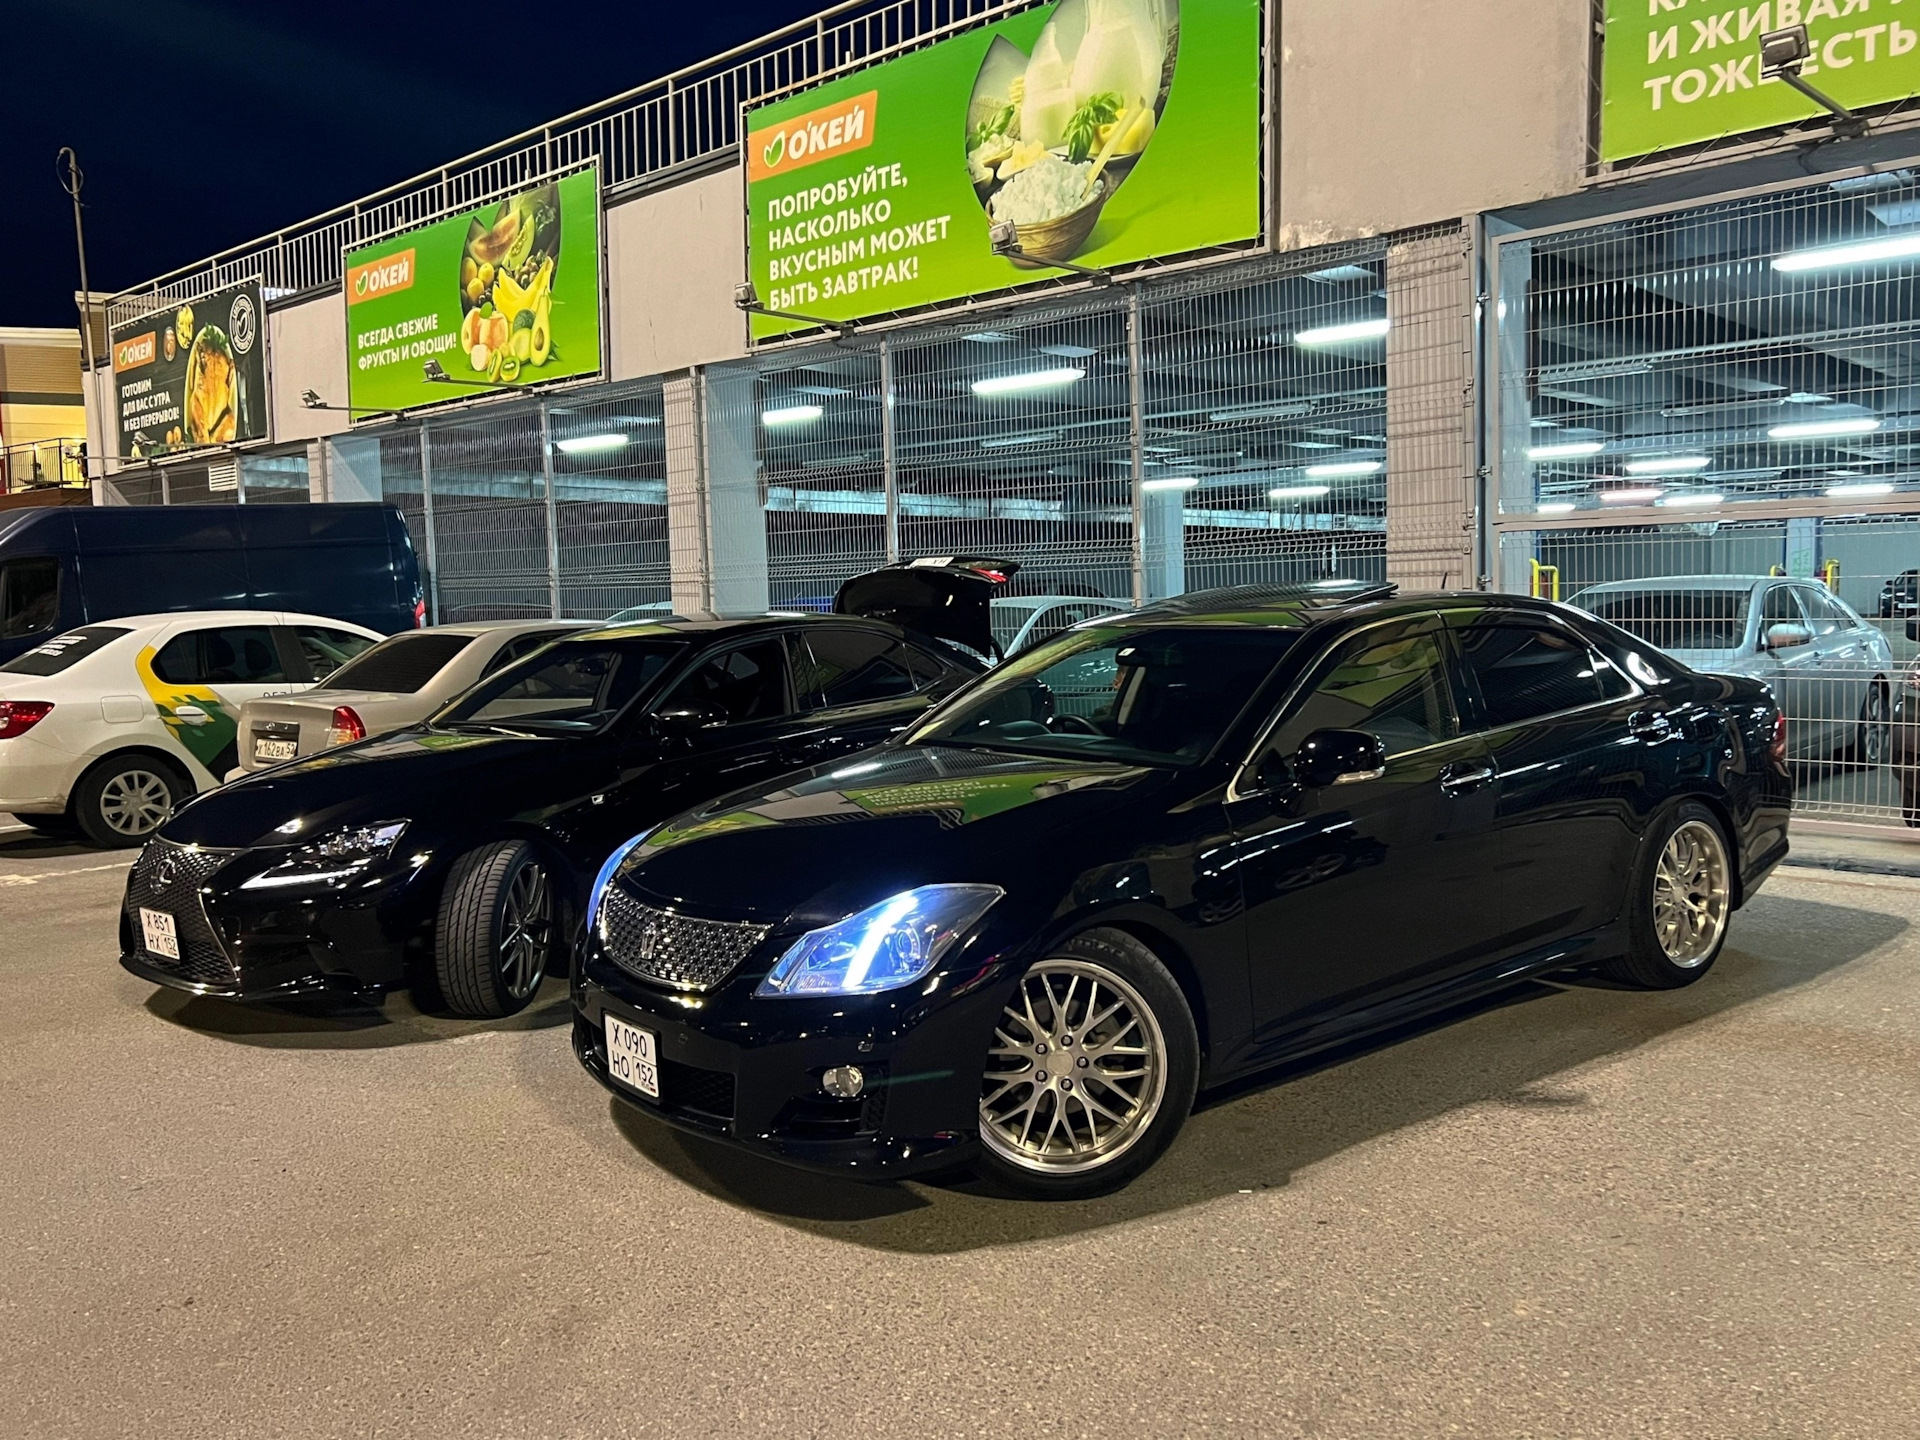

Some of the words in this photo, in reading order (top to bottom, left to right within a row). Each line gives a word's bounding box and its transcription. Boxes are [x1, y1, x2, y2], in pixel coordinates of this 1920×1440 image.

[1647, 25, 1678, 64] И
[768, 162, 908, 222] ПОПРОБУЙТЕ,
[768, 199, 891, 251] НАСКОЛЬКО
[769, 237, 865, 281] ВКУСНЫМ
[870, 215, 951, 257] МОЖЕТ
[769, 280, 818, 311] БЫТЬ
[822, 256, 919, 299] ЗАВТРАК!
[358, 326, 395, 349] ВСЕГДА
[395, 313, 438, 339] СВЕЖИЕ
[358, 347, 400, 371] ФРУКТЫ
[401, 344, 410, 360] И
[411, 332, 457, 357] ОВОЩИ!
[121, 378, 152, 398] ГОТОВИМ
[122, 400, 136, 417] ДЛЯ
[136, 397, 148, 412] ВАС
[148, 395, 154, 408] С
[153, 390, 171, 407] УТРА
[123, 419, 130, 432] И
[129, 416, 140, 431] БЕЗ
[140, 406, 180, 428] ПЕРЕРЫВОВ!
[153, 913, 171, 933] 851
[164, 936, 177, 952] 152
[624, 1028, 647, 1058] 090
[612, 1050, 630, 1078] НО
[636, 1062, 655, 1086] 152
